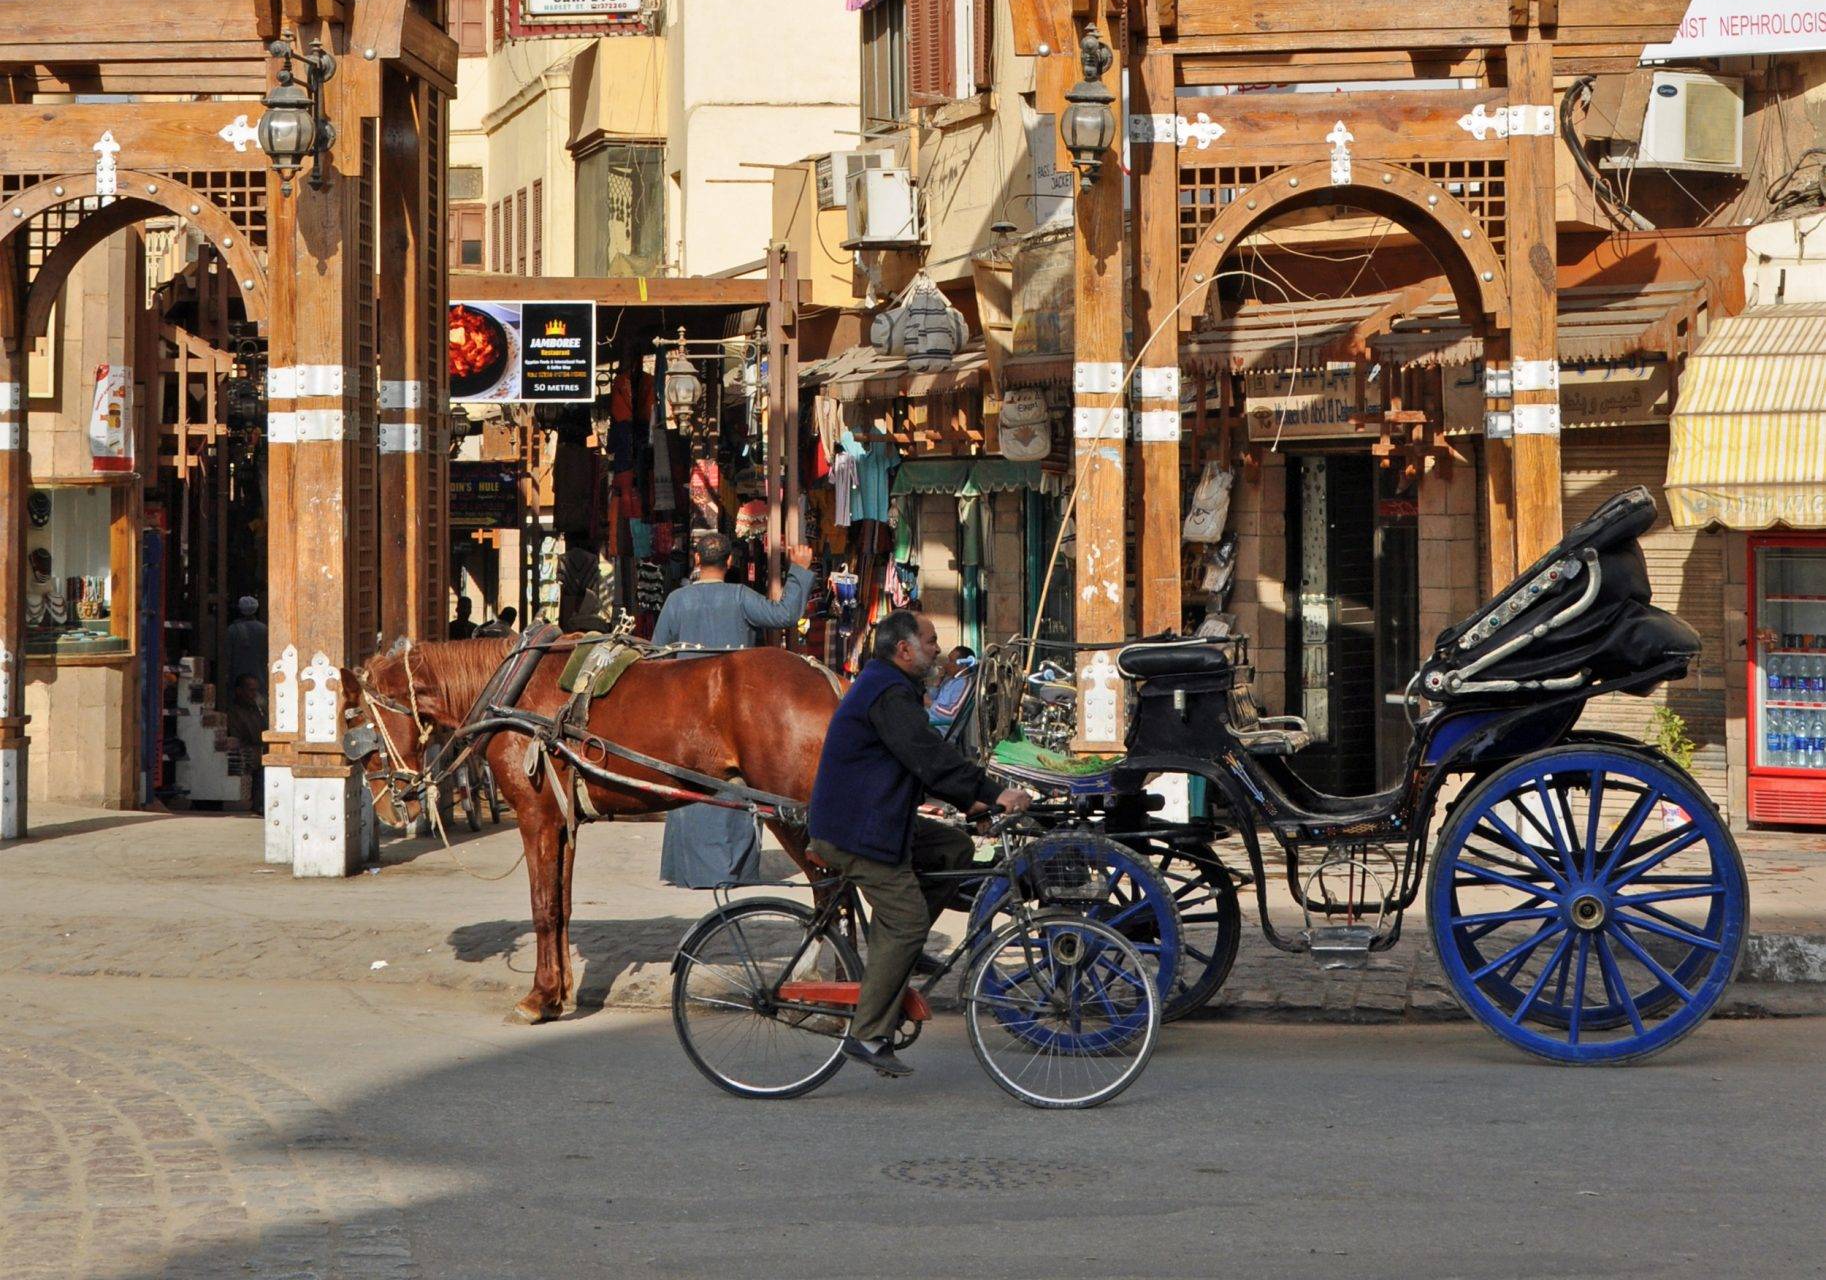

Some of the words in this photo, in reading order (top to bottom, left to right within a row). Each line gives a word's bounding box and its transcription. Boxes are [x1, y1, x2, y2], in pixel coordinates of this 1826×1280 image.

[1720, 11, 1826, 37] NEPHROLOGIS
[530, 338, 581, 348] JAMBOREE
[534, 383, 546, 392] 50
[547, 384, 580, 392] METRES
